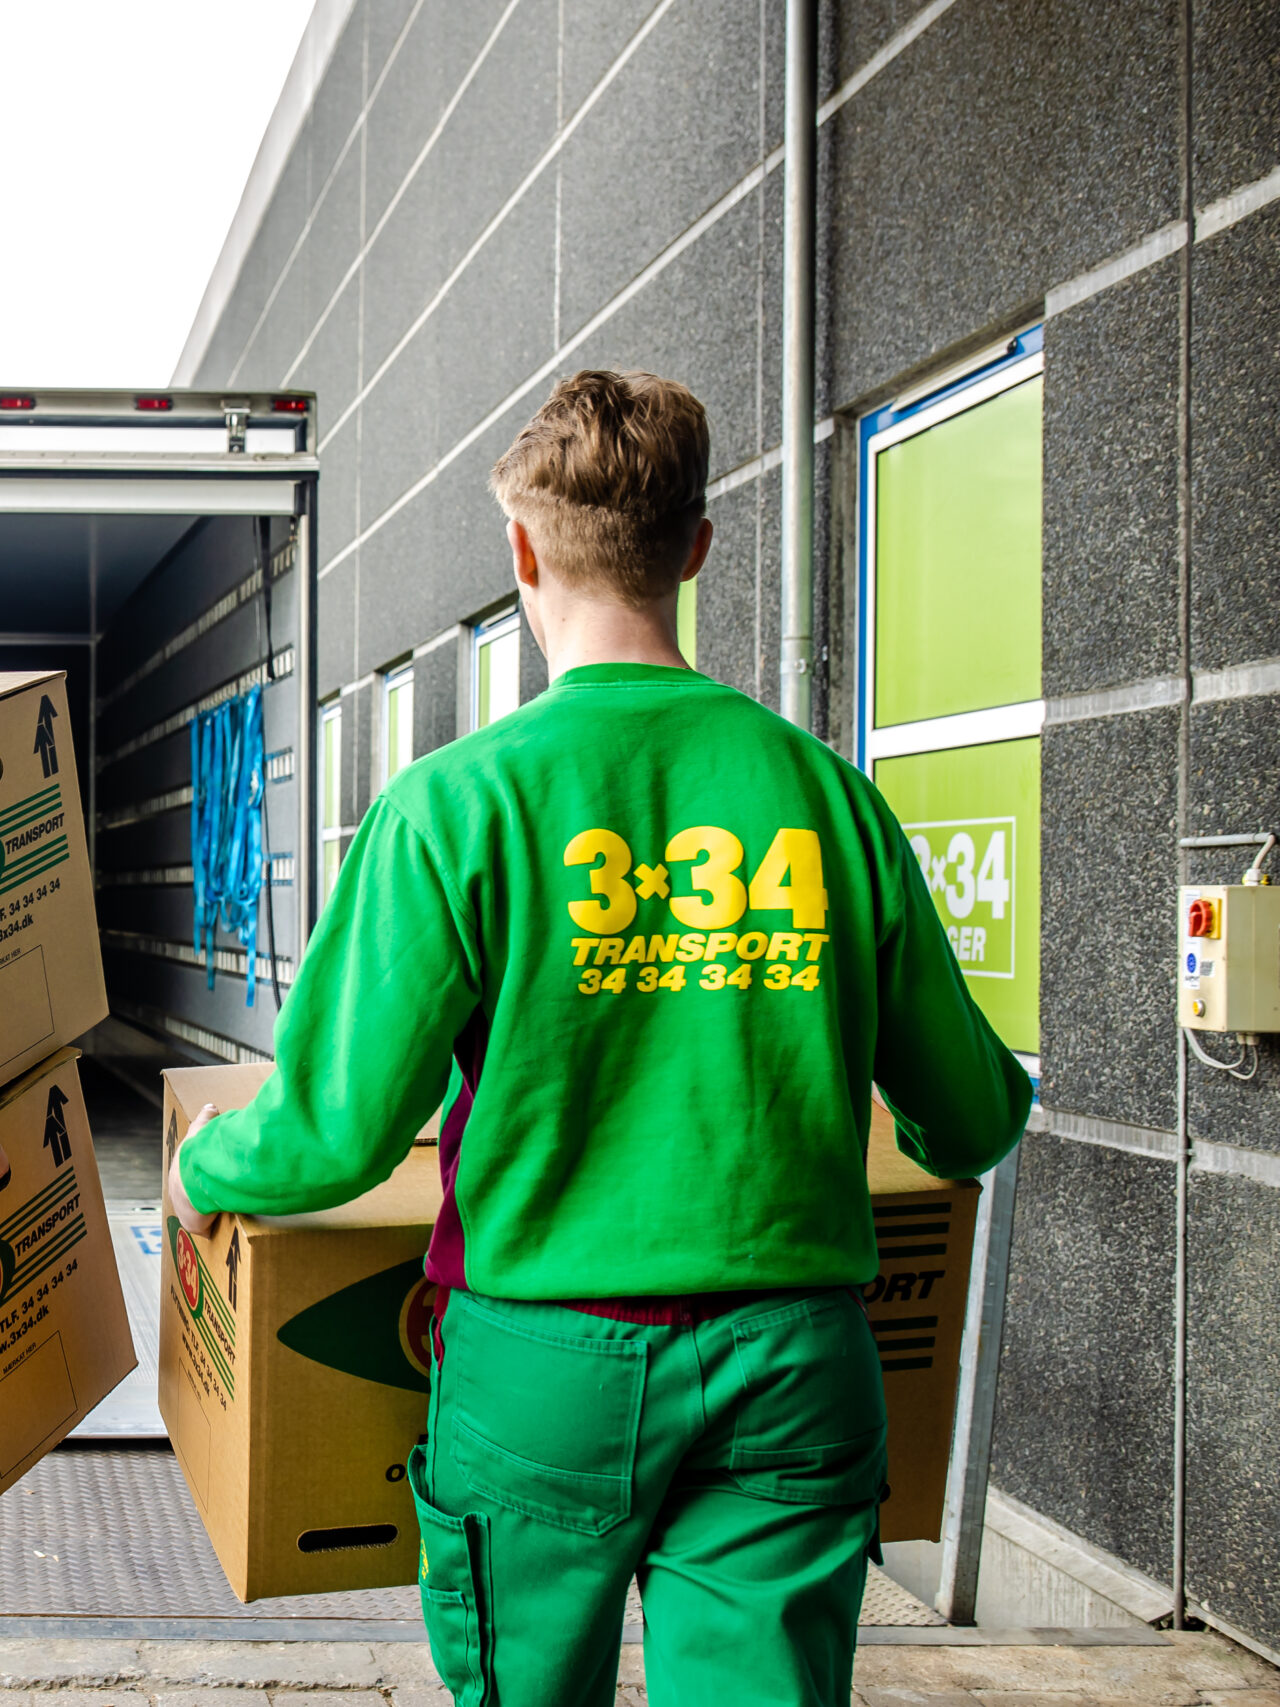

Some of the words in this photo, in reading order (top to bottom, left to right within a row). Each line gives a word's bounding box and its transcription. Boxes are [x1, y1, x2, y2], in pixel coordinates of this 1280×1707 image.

[5, 813, 65, 855] TRANSPORT
[9, 899, 21, 916] 34
[22, 892, 35, 908] 34
[36, 884, 48, 901] 34
[49, 877, 61, 893] 34
[570, 931, 830, 966] TRANSPORT
[577, 967, 627, 995] 34
[636, 965, 687, 993] 34
[699, 963, 753, 991] 34
[763, 963, 820, 992] 34
[14, 1193, 81, 1257] TRANSPORT
[21, 1296, 35, 1315] 34
[36, 1284, 49, 1302] 34
[51, 1271, 64, 1289] 34
[66, 1258, 78, 1277] 34
[204, 1296, 236, 1366] TRANSPORT
